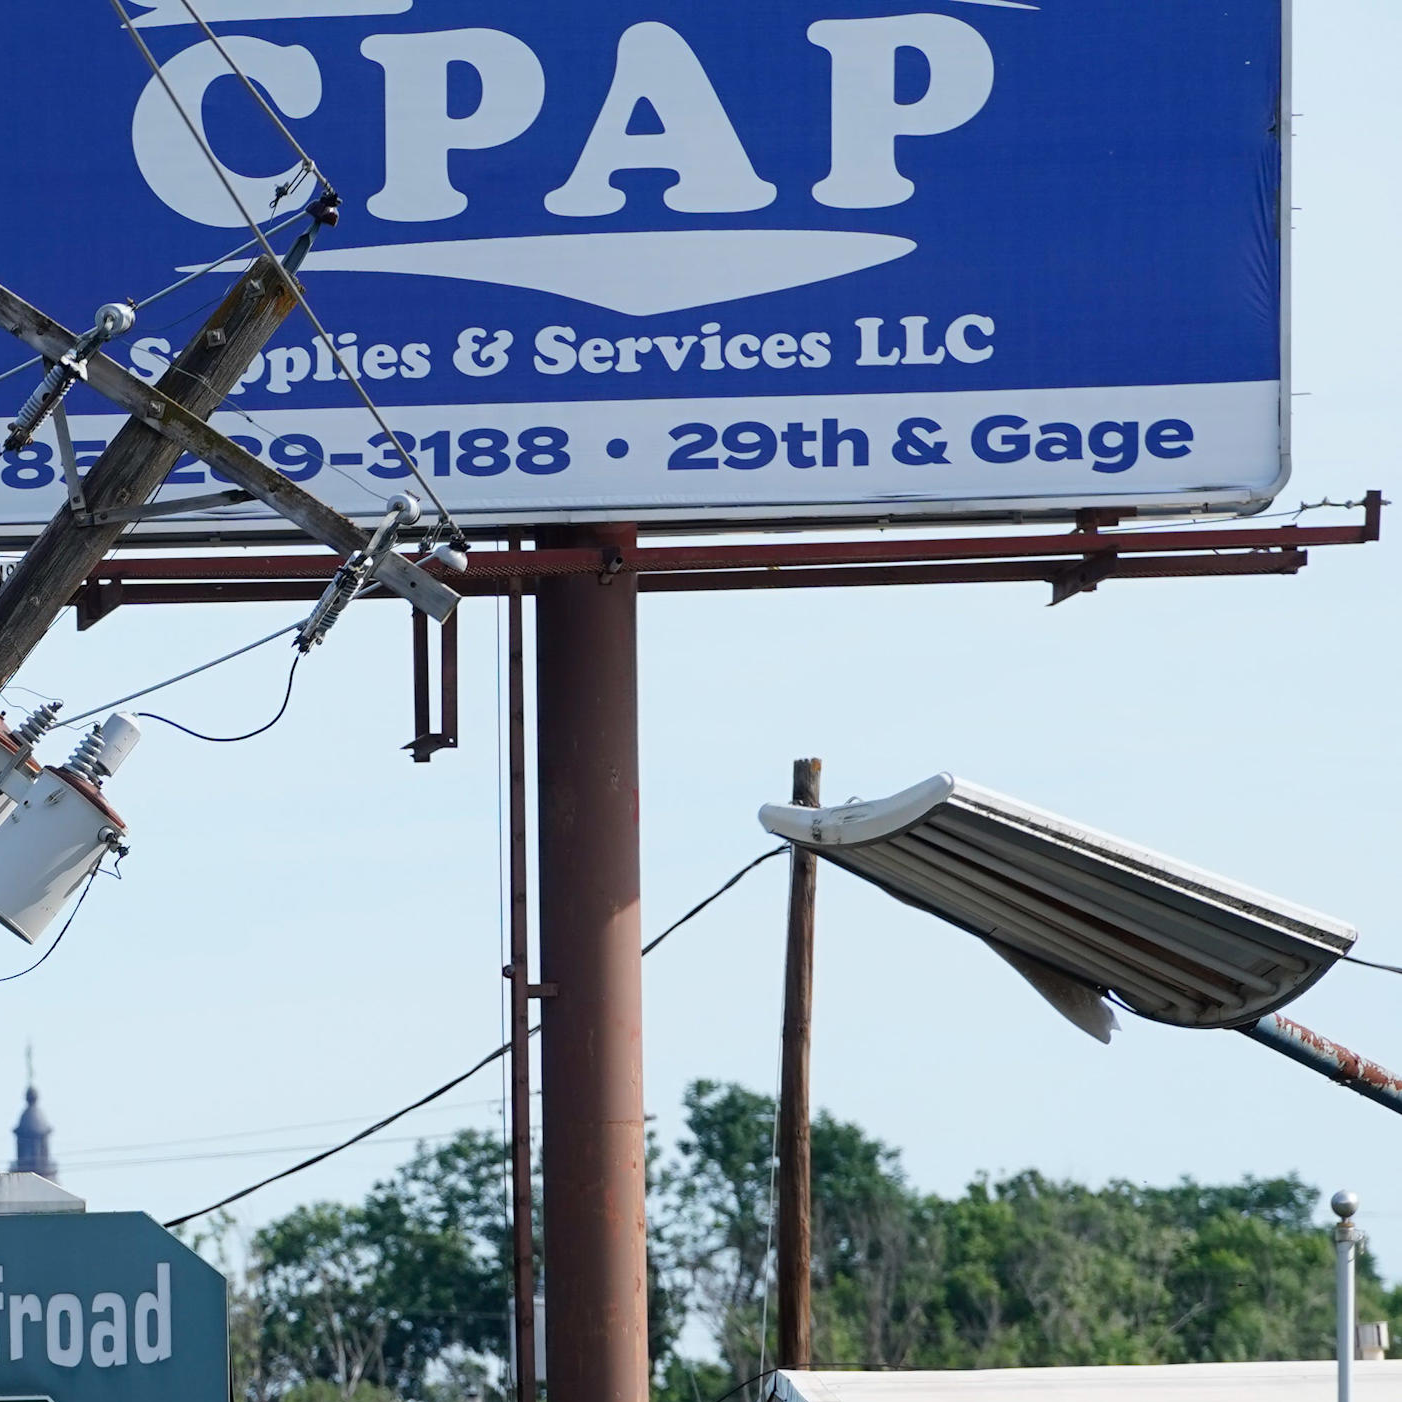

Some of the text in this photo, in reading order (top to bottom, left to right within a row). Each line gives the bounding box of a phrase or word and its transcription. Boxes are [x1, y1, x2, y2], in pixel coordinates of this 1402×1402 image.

[132, 13, 995, 228] CPAP
[452, 327, 514, 377] &
[533, 322, 832, 376] Services
[854, 314, 996, 367] LLC
[667, 417, 869, 472] 29th
[892, 417, 952, 466] &
[970, 414, 1194, 474] Gage
